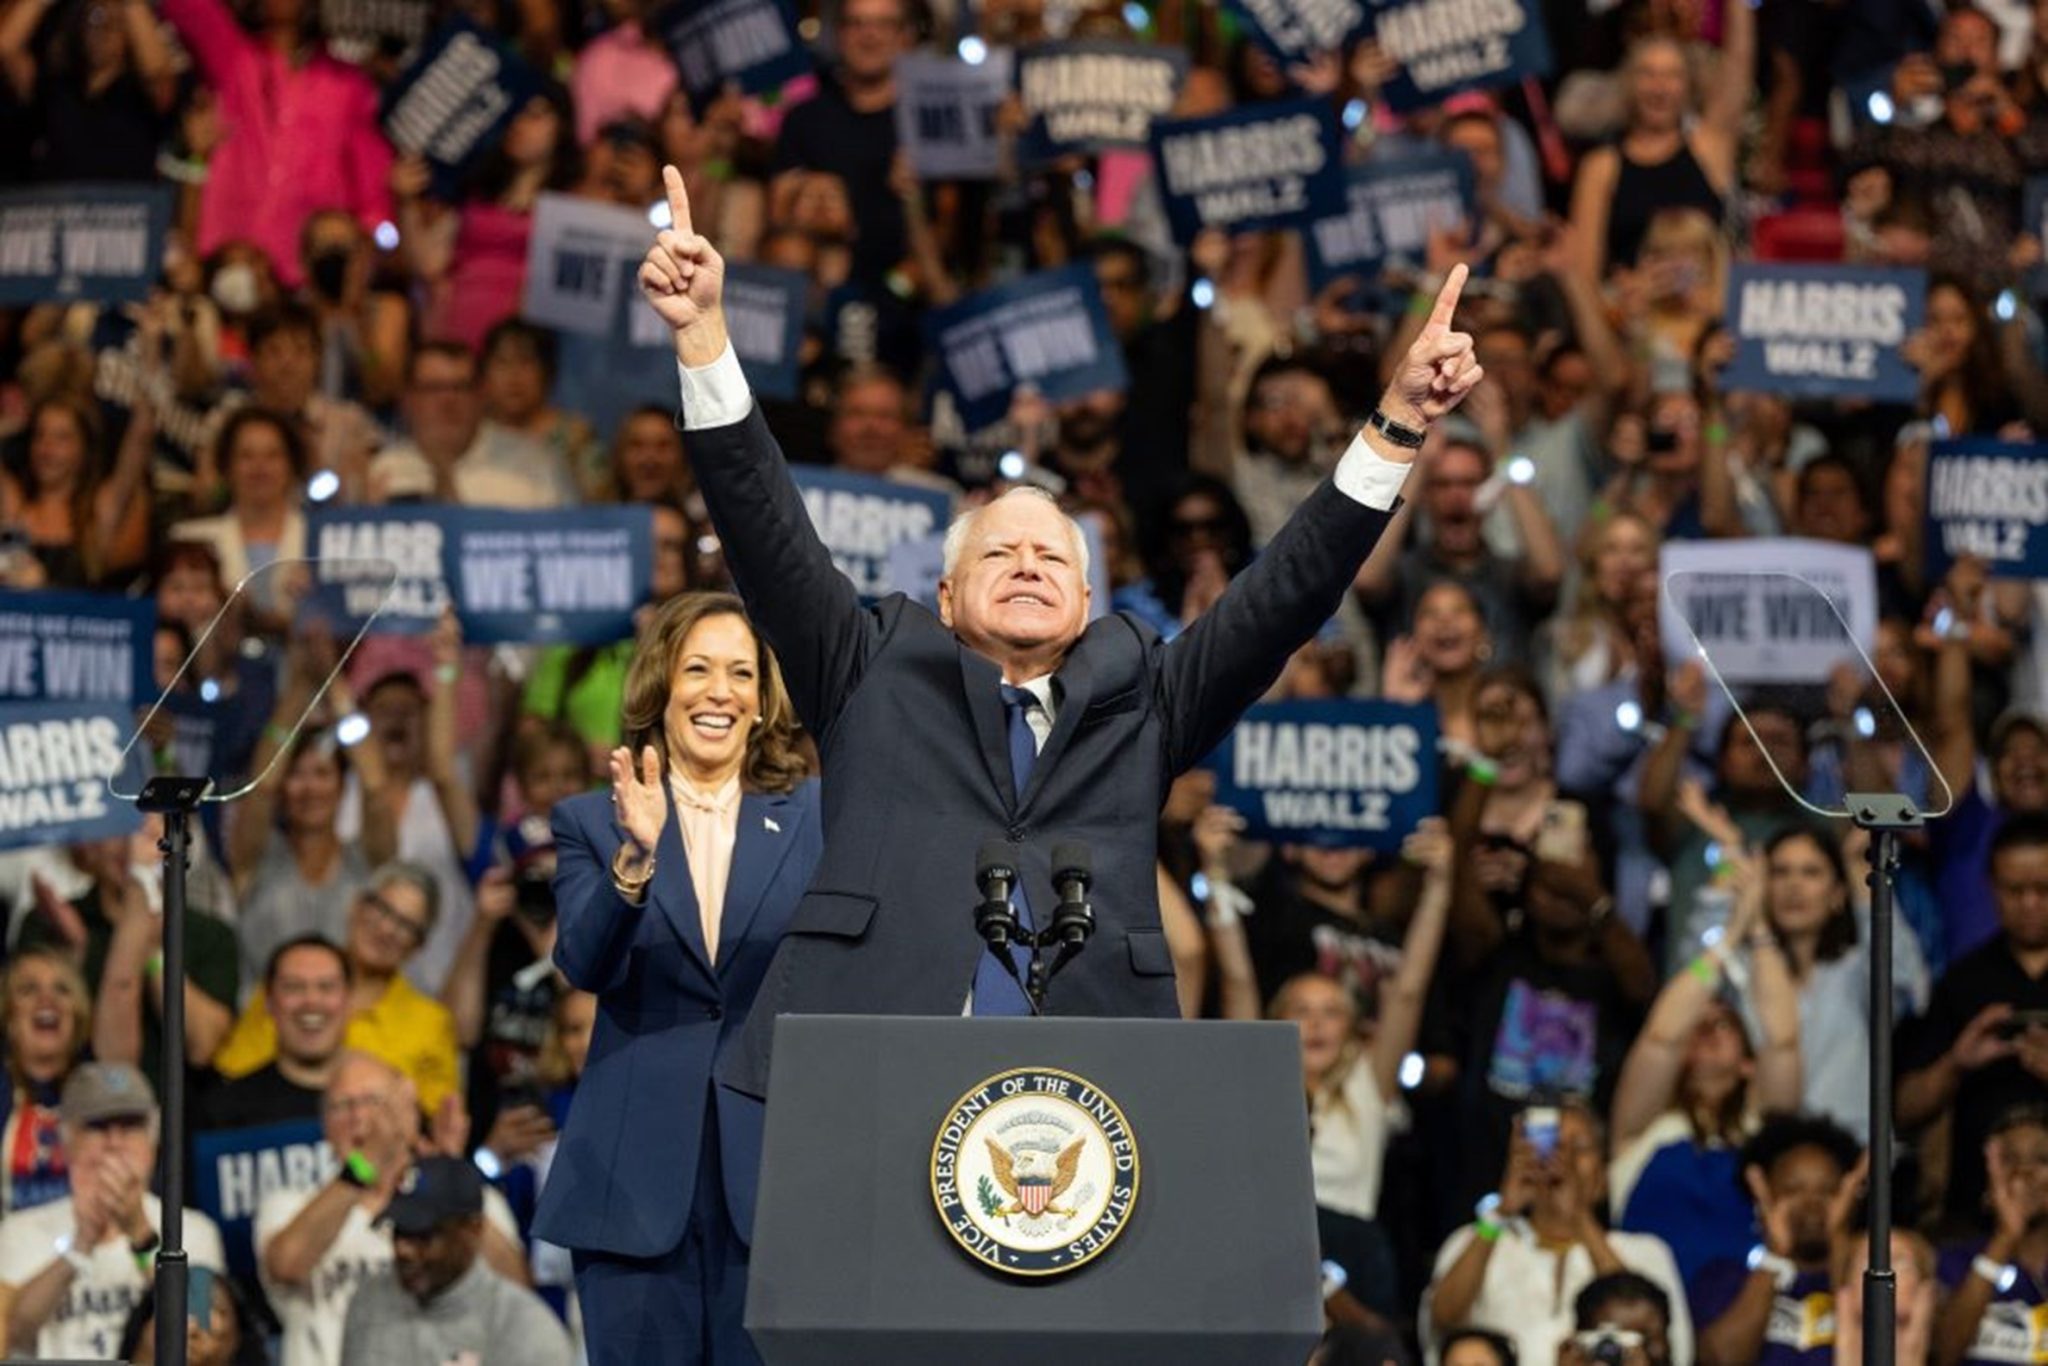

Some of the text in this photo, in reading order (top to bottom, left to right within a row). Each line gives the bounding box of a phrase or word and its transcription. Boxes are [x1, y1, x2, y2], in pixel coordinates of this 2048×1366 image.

[1161, 113, 1327, 196] HARRIS
[1194, 175, 1310, 224] WALZ
[1739, 279, 1907, 346] HARRIS
[1765, 340, 1879, 379] WALZ
[1930, 454, 2048, 526] HARRIS
[460, 553, 634, 613] WE WIN
[1686, 593, 1851, 642] WE WIN
[43, 639, 134, 699] WIN
[1233, 719, 1421, 794] HARRIS
[1262, 789, 1391, 831] WALZ
[1001, 1077, 1026, 1095] OF
[1033, 1076, 1070, 1096] THE
[936, 1087, 993, 1208] PRESIDENT
[1077, 1088, 1134, 1172] UNITED
[953, 1214, 1000, 1262] VICE
[1069, 1184, 1132, 1261] STATES
